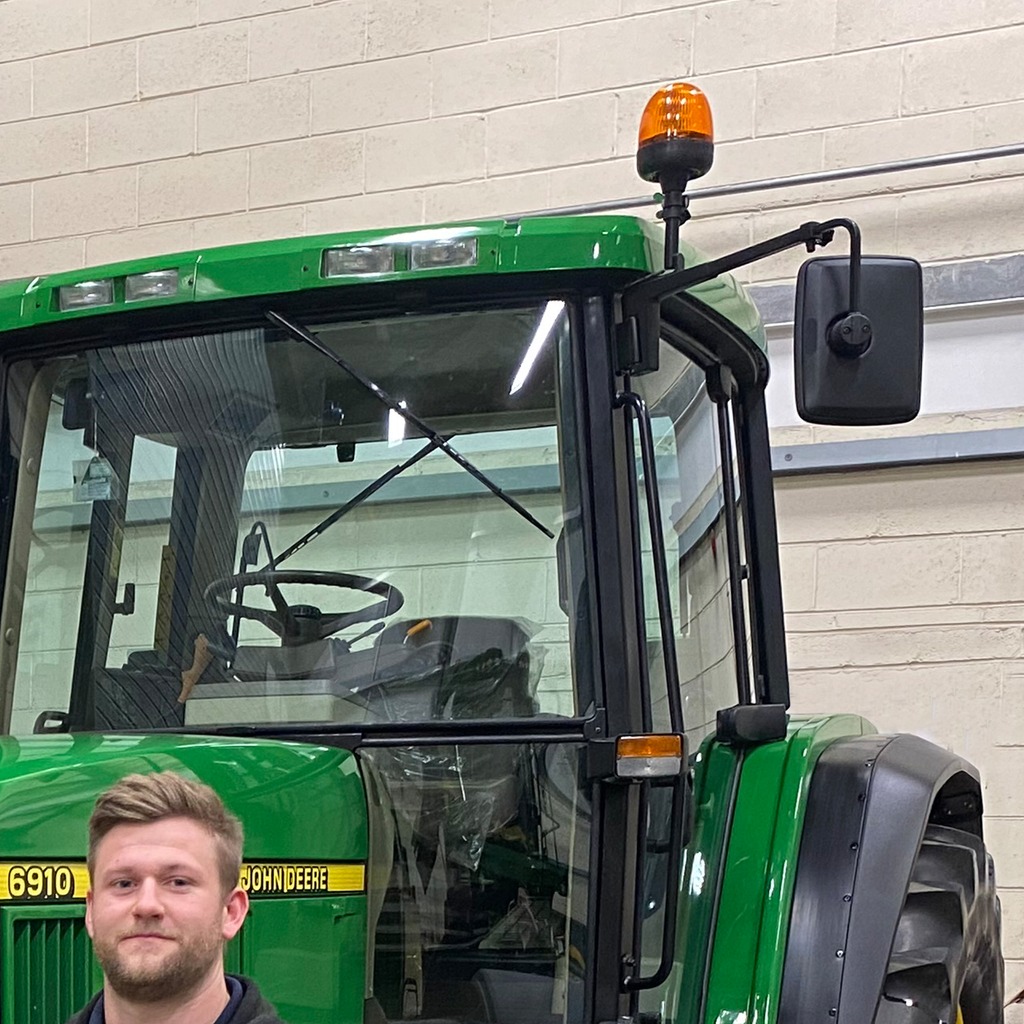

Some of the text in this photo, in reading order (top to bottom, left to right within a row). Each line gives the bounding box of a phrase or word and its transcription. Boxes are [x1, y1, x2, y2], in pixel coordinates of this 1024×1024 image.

[8, 866, 75, 898] 6910
[241, 865, 329, 892] JOHN DEERE
